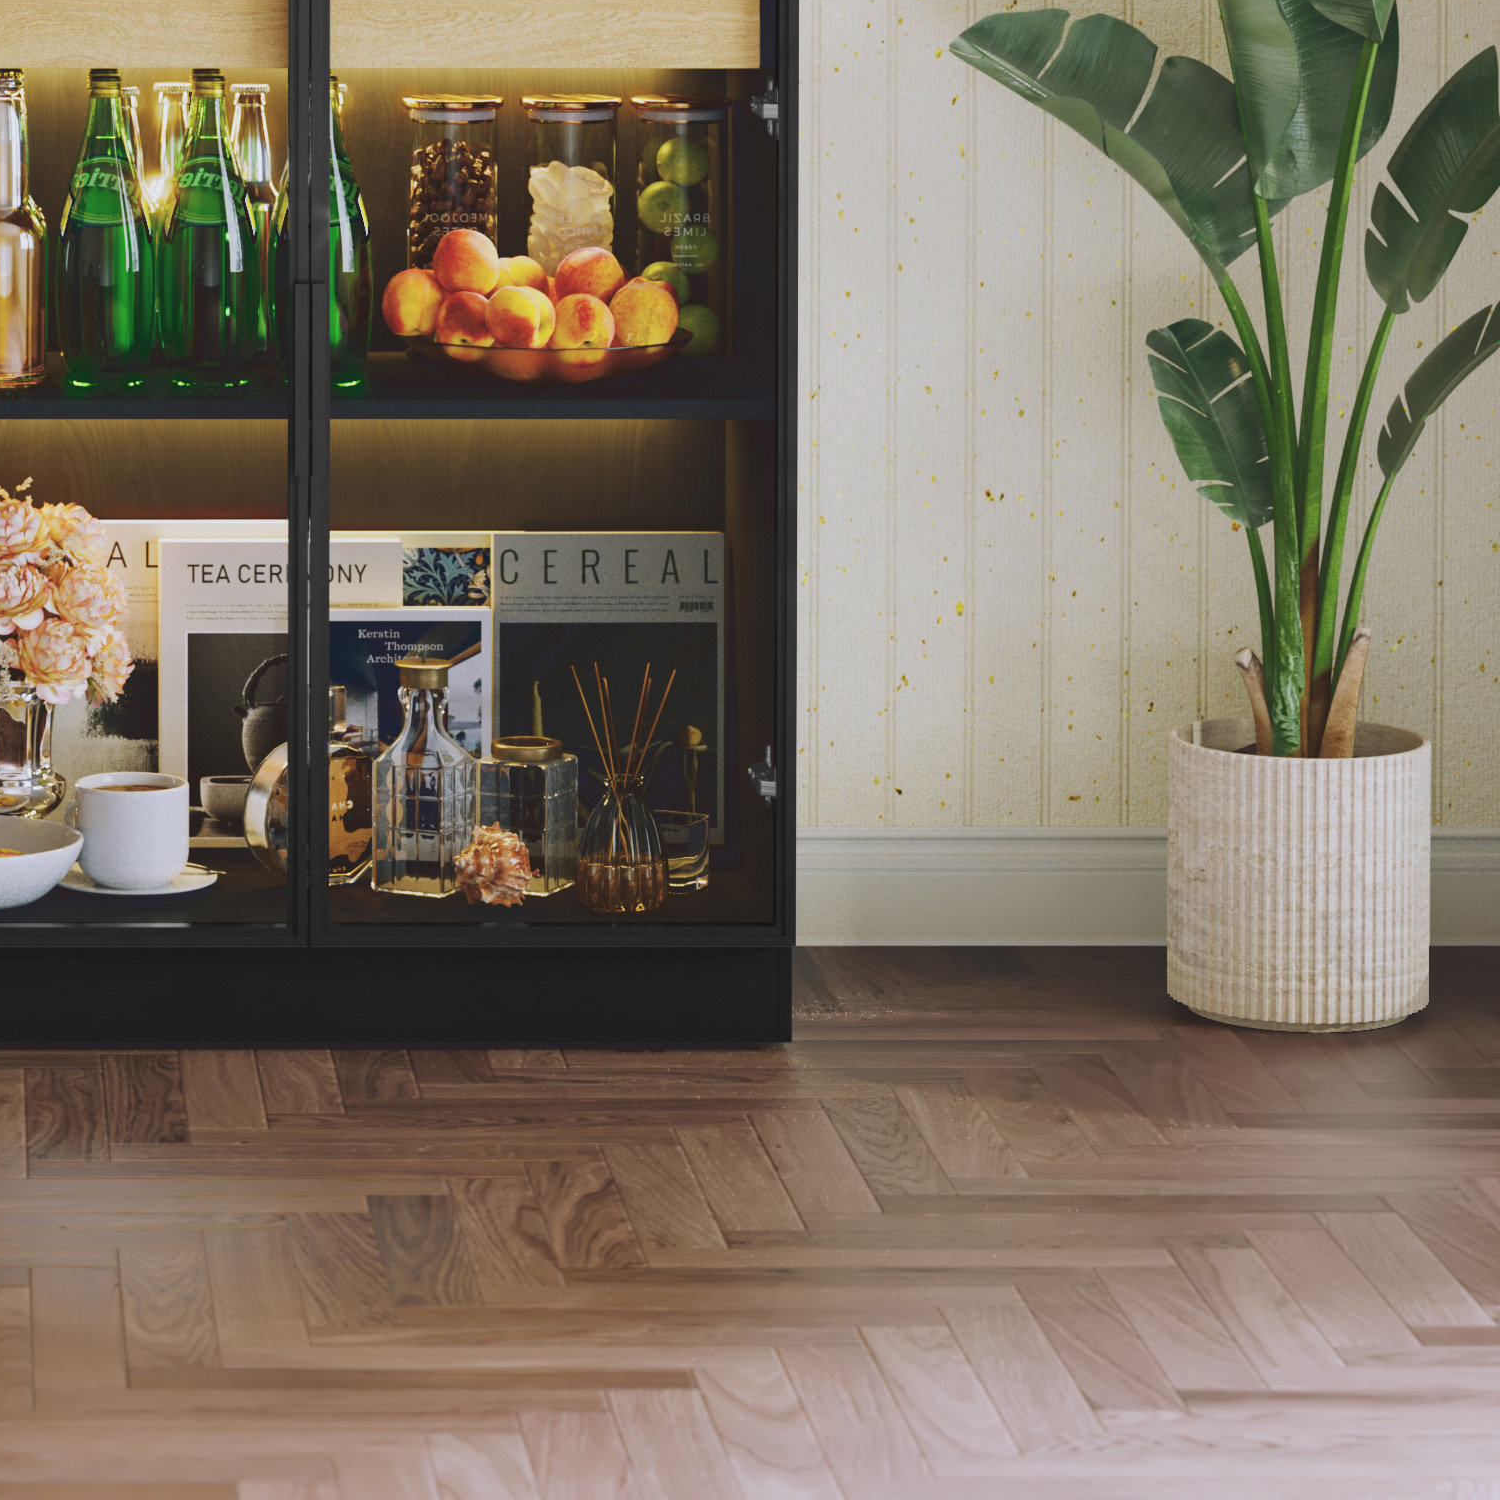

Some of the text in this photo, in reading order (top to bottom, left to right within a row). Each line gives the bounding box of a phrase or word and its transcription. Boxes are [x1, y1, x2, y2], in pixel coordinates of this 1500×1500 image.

[187, 564, 230, 583] TEA
[499, 549, 718, 585] CEREAL
[357, 629, 400, 639] Kerstin
[384, 641, 444, 653] Thompson
